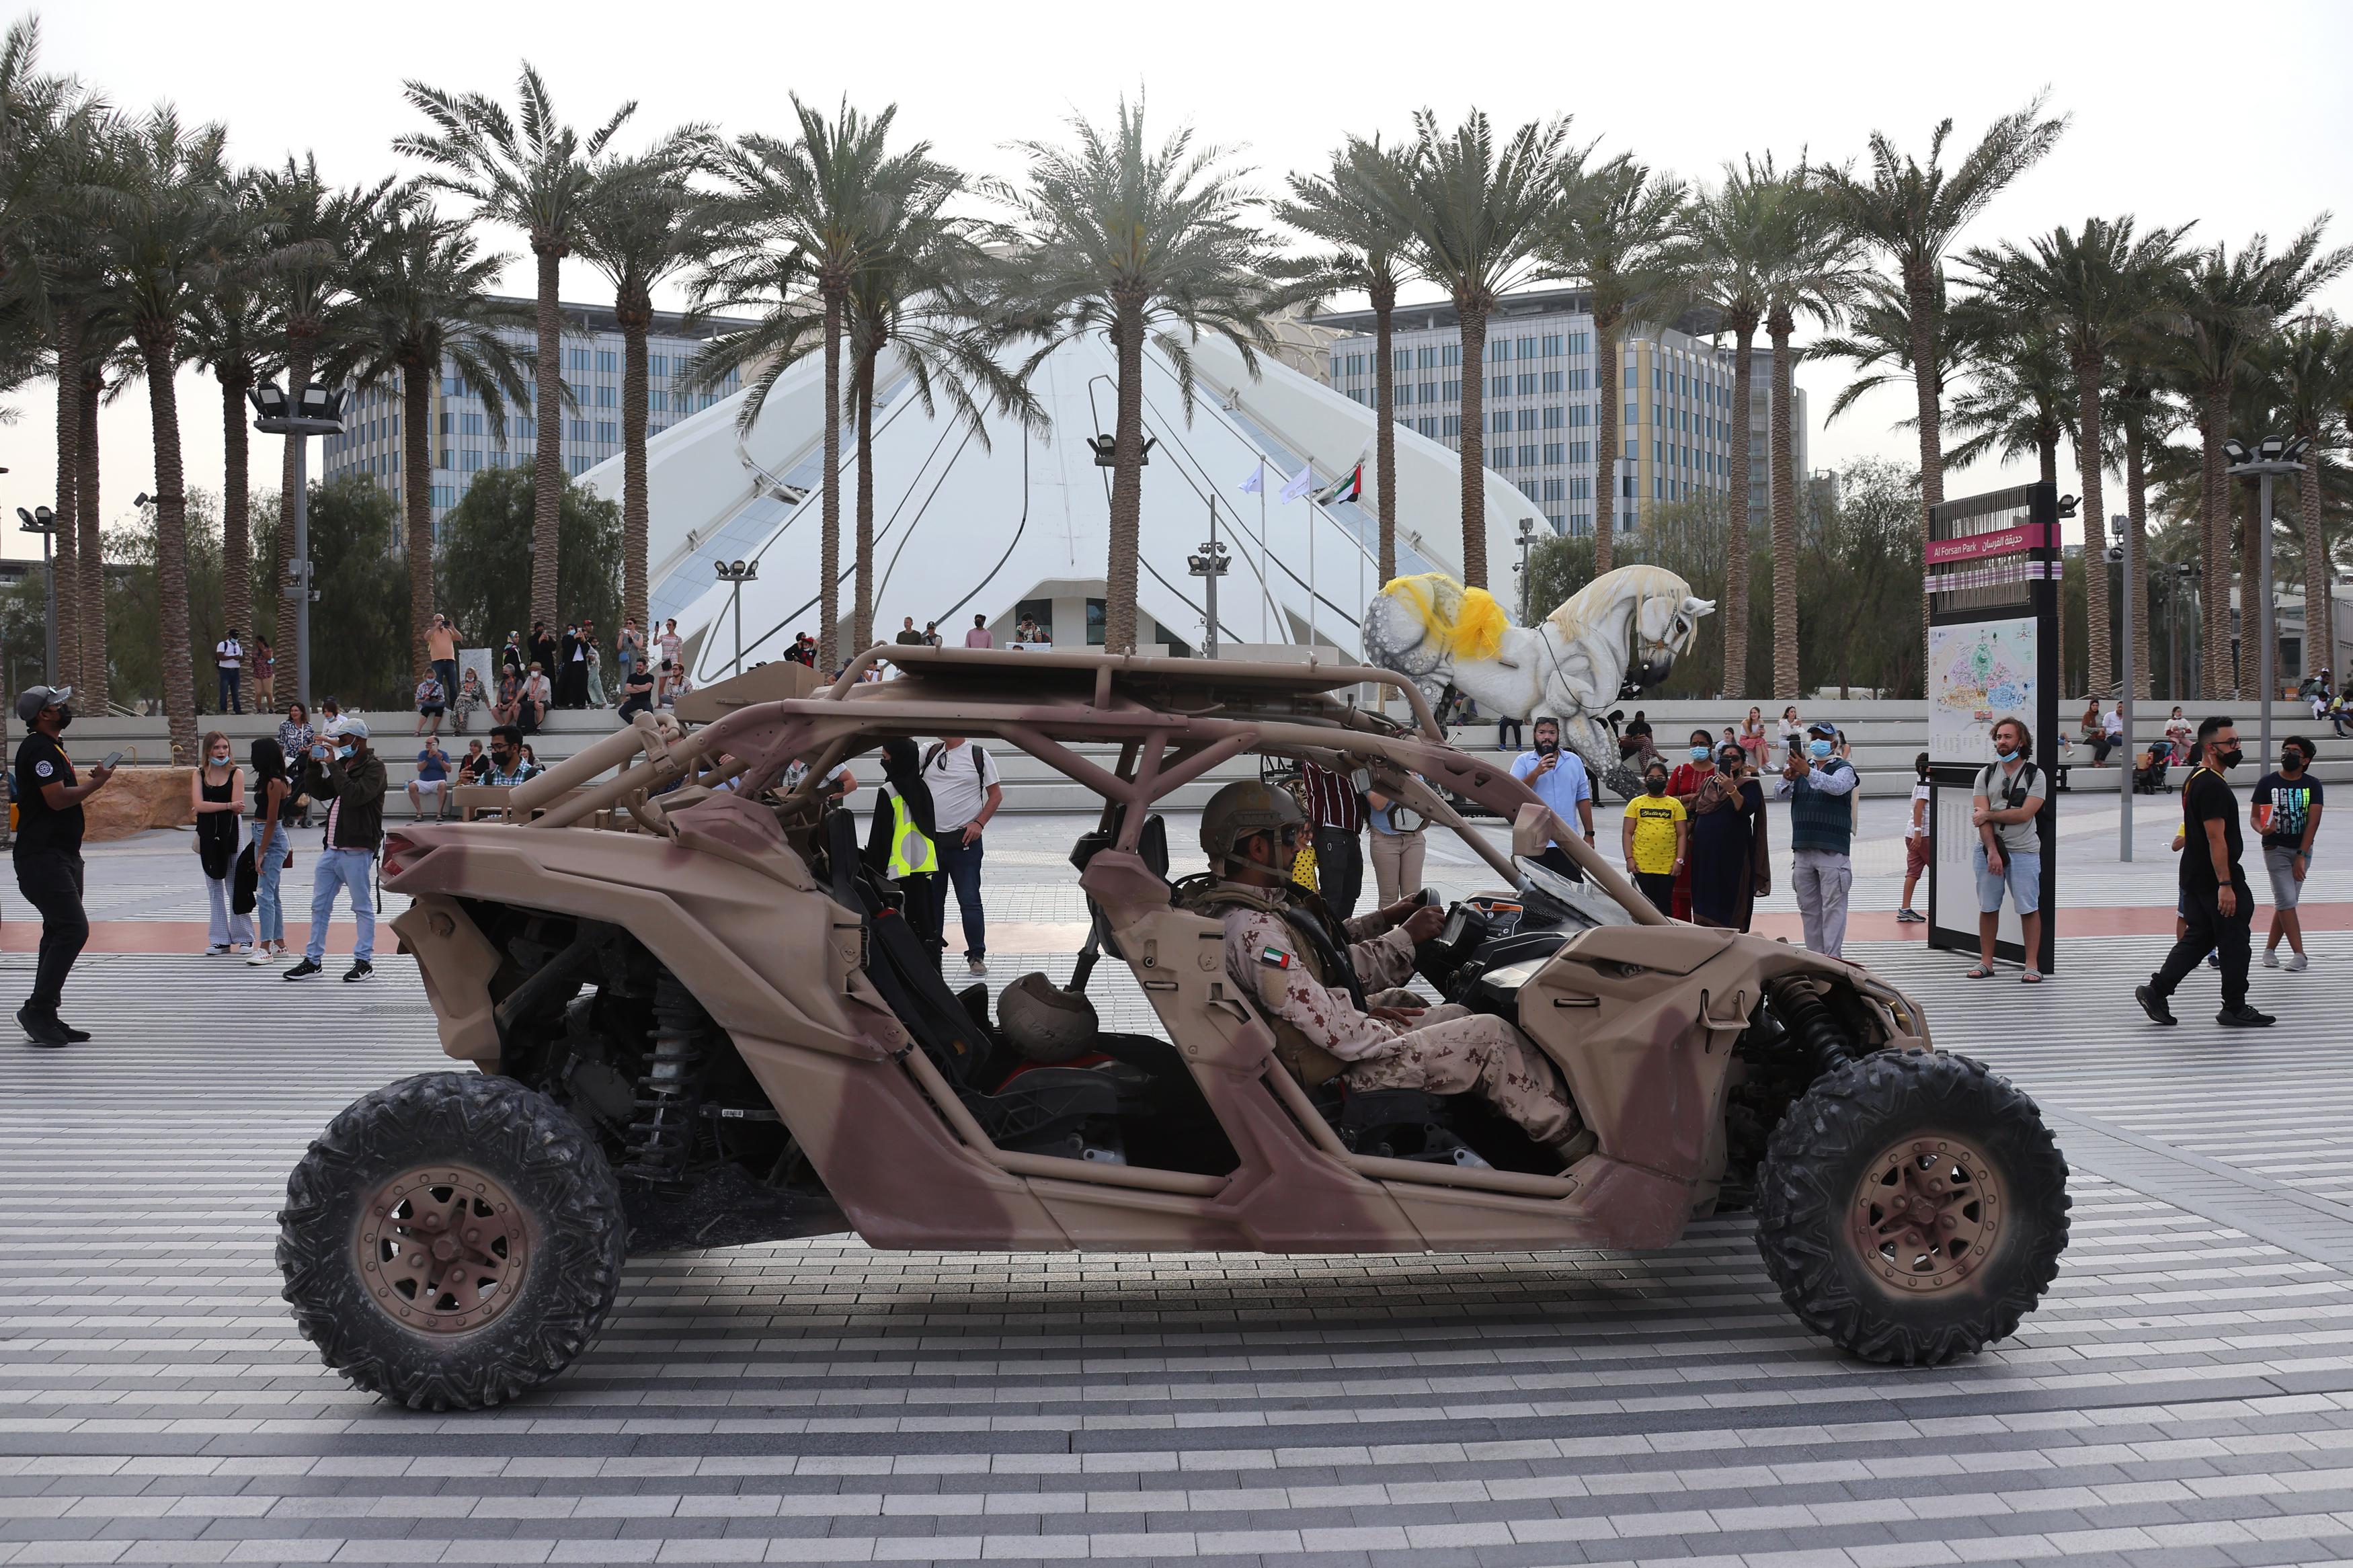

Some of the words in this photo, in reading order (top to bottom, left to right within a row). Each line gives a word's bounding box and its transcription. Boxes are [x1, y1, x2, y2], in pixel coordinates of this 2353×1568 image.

[1982, 537, 2004, 552] الفرسان
[2005, 534, 2023, 547] حديقة
[1933, 548, 1941, 557] Al
[1941, 546, 1962, 556] Forsan
[1962, 542, 1977, 552] Park
